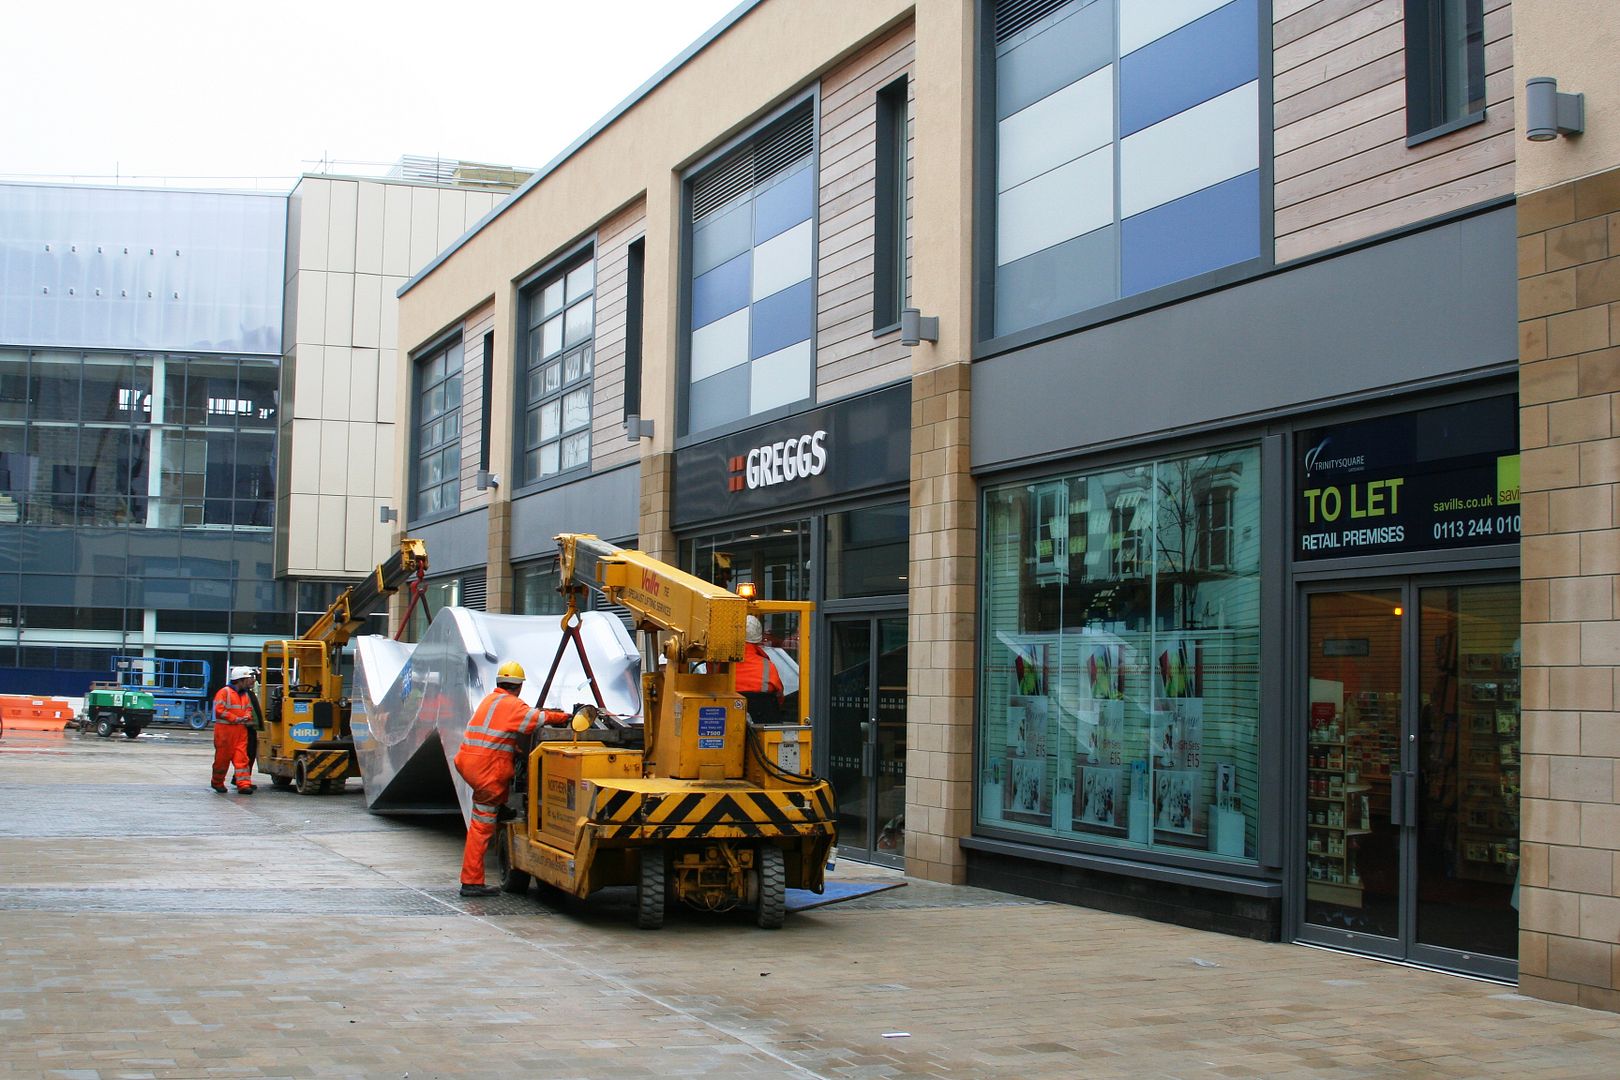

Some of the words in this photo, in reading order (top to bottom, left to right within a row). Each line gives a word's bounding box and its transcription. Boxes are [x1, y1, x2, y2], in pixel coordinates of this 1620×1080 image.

[746, 430, 827, 490] GREGGS
[1303, 486, 1342, 523] TO
[1350, 478, 1404, 519] LET
[1433, 494, 1493, 512] savills.co.uk
[1302, 532, 1340, 550] RETAIL
[1343, 525, 1405, 546] PREMISES
[1433, 521, 1464, 539] 0113
[1468, 517, 1493, 537] 244
